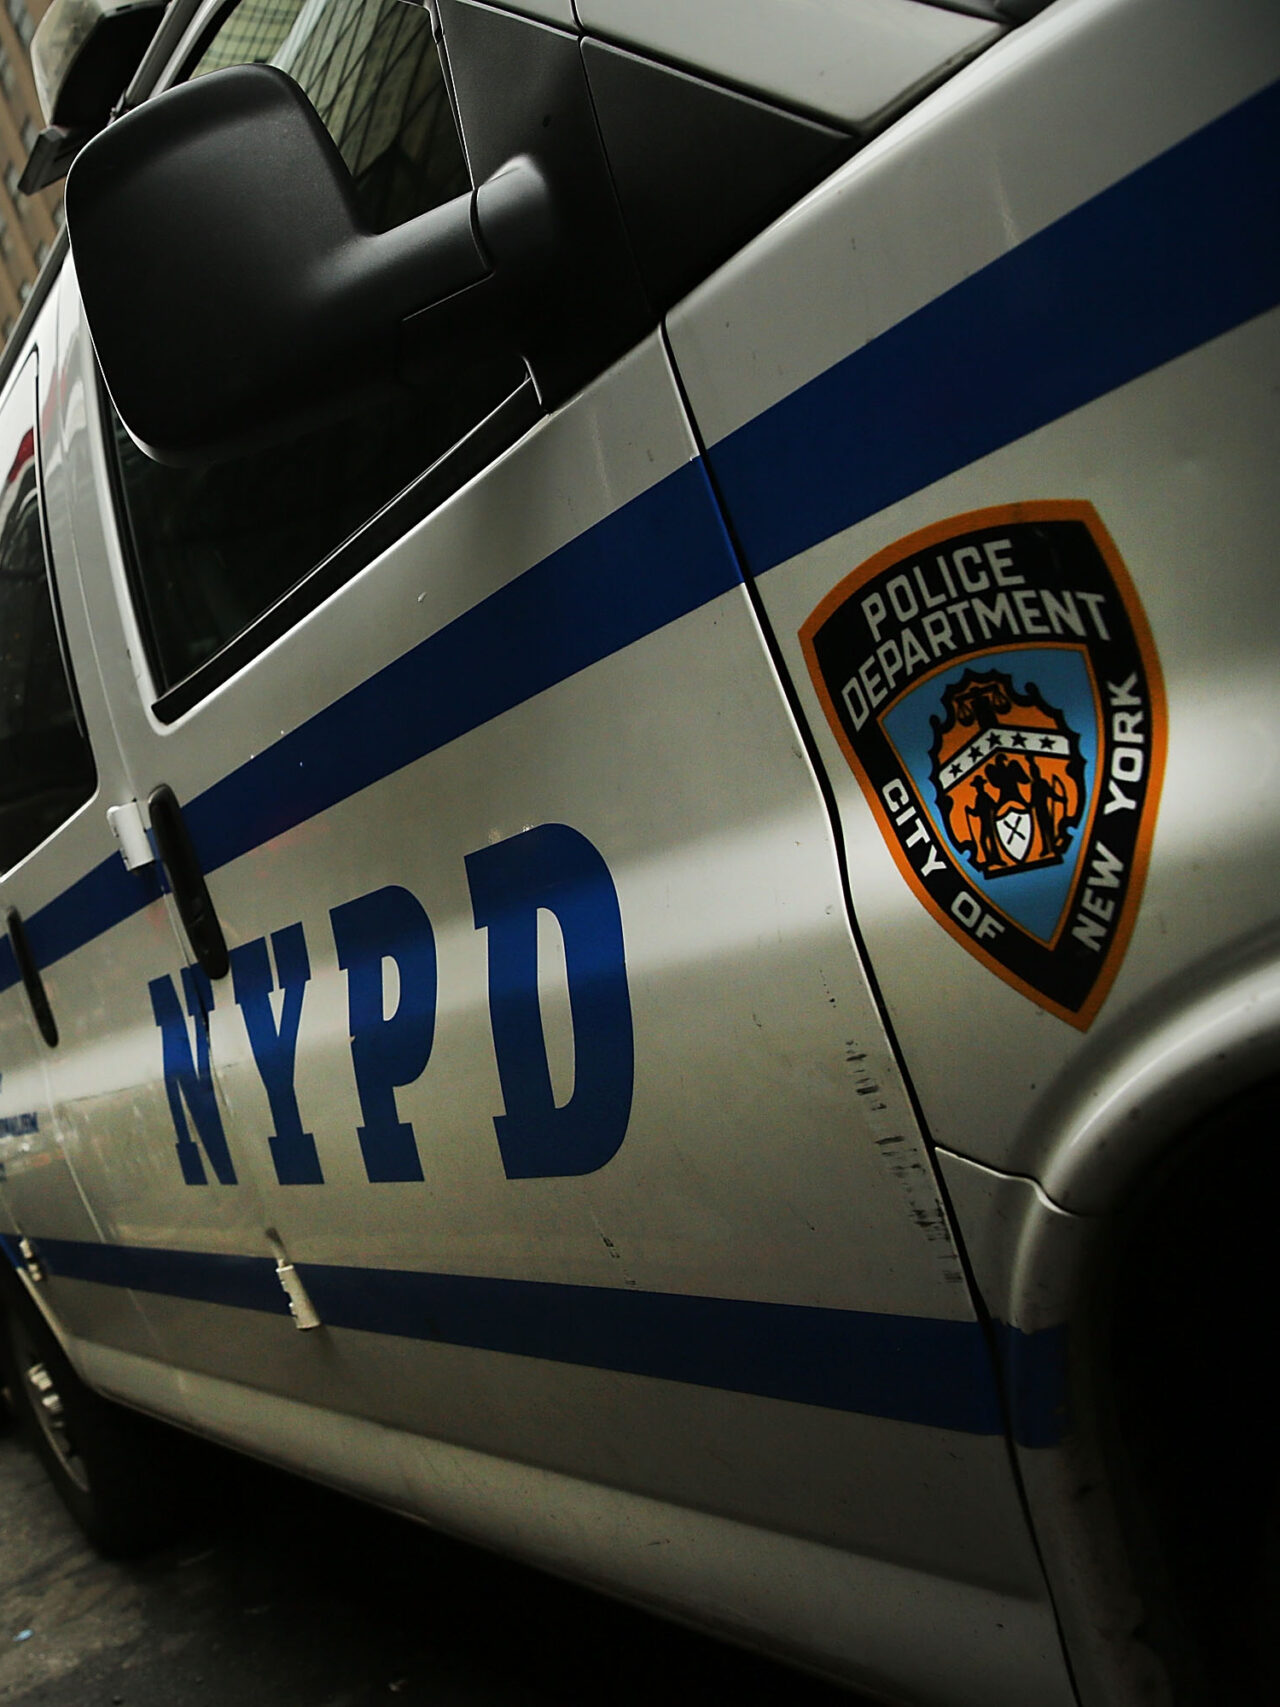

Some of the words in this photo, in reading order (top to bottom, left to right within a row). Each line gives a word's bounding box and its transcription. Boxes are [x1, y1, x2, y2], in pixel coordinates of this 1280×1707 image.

[840, 589, 1112, 732] DEPARTMENT
[861, 538, 1026, 642] POLICE
[881, 778, 947, 877] CITY
[950, 890, 1006, 942] OF
[1071, 841, 1124, 952] NEW
[1104, 670, 1144, 816] YORK
[147, 822, 635, 1185] NYPD
